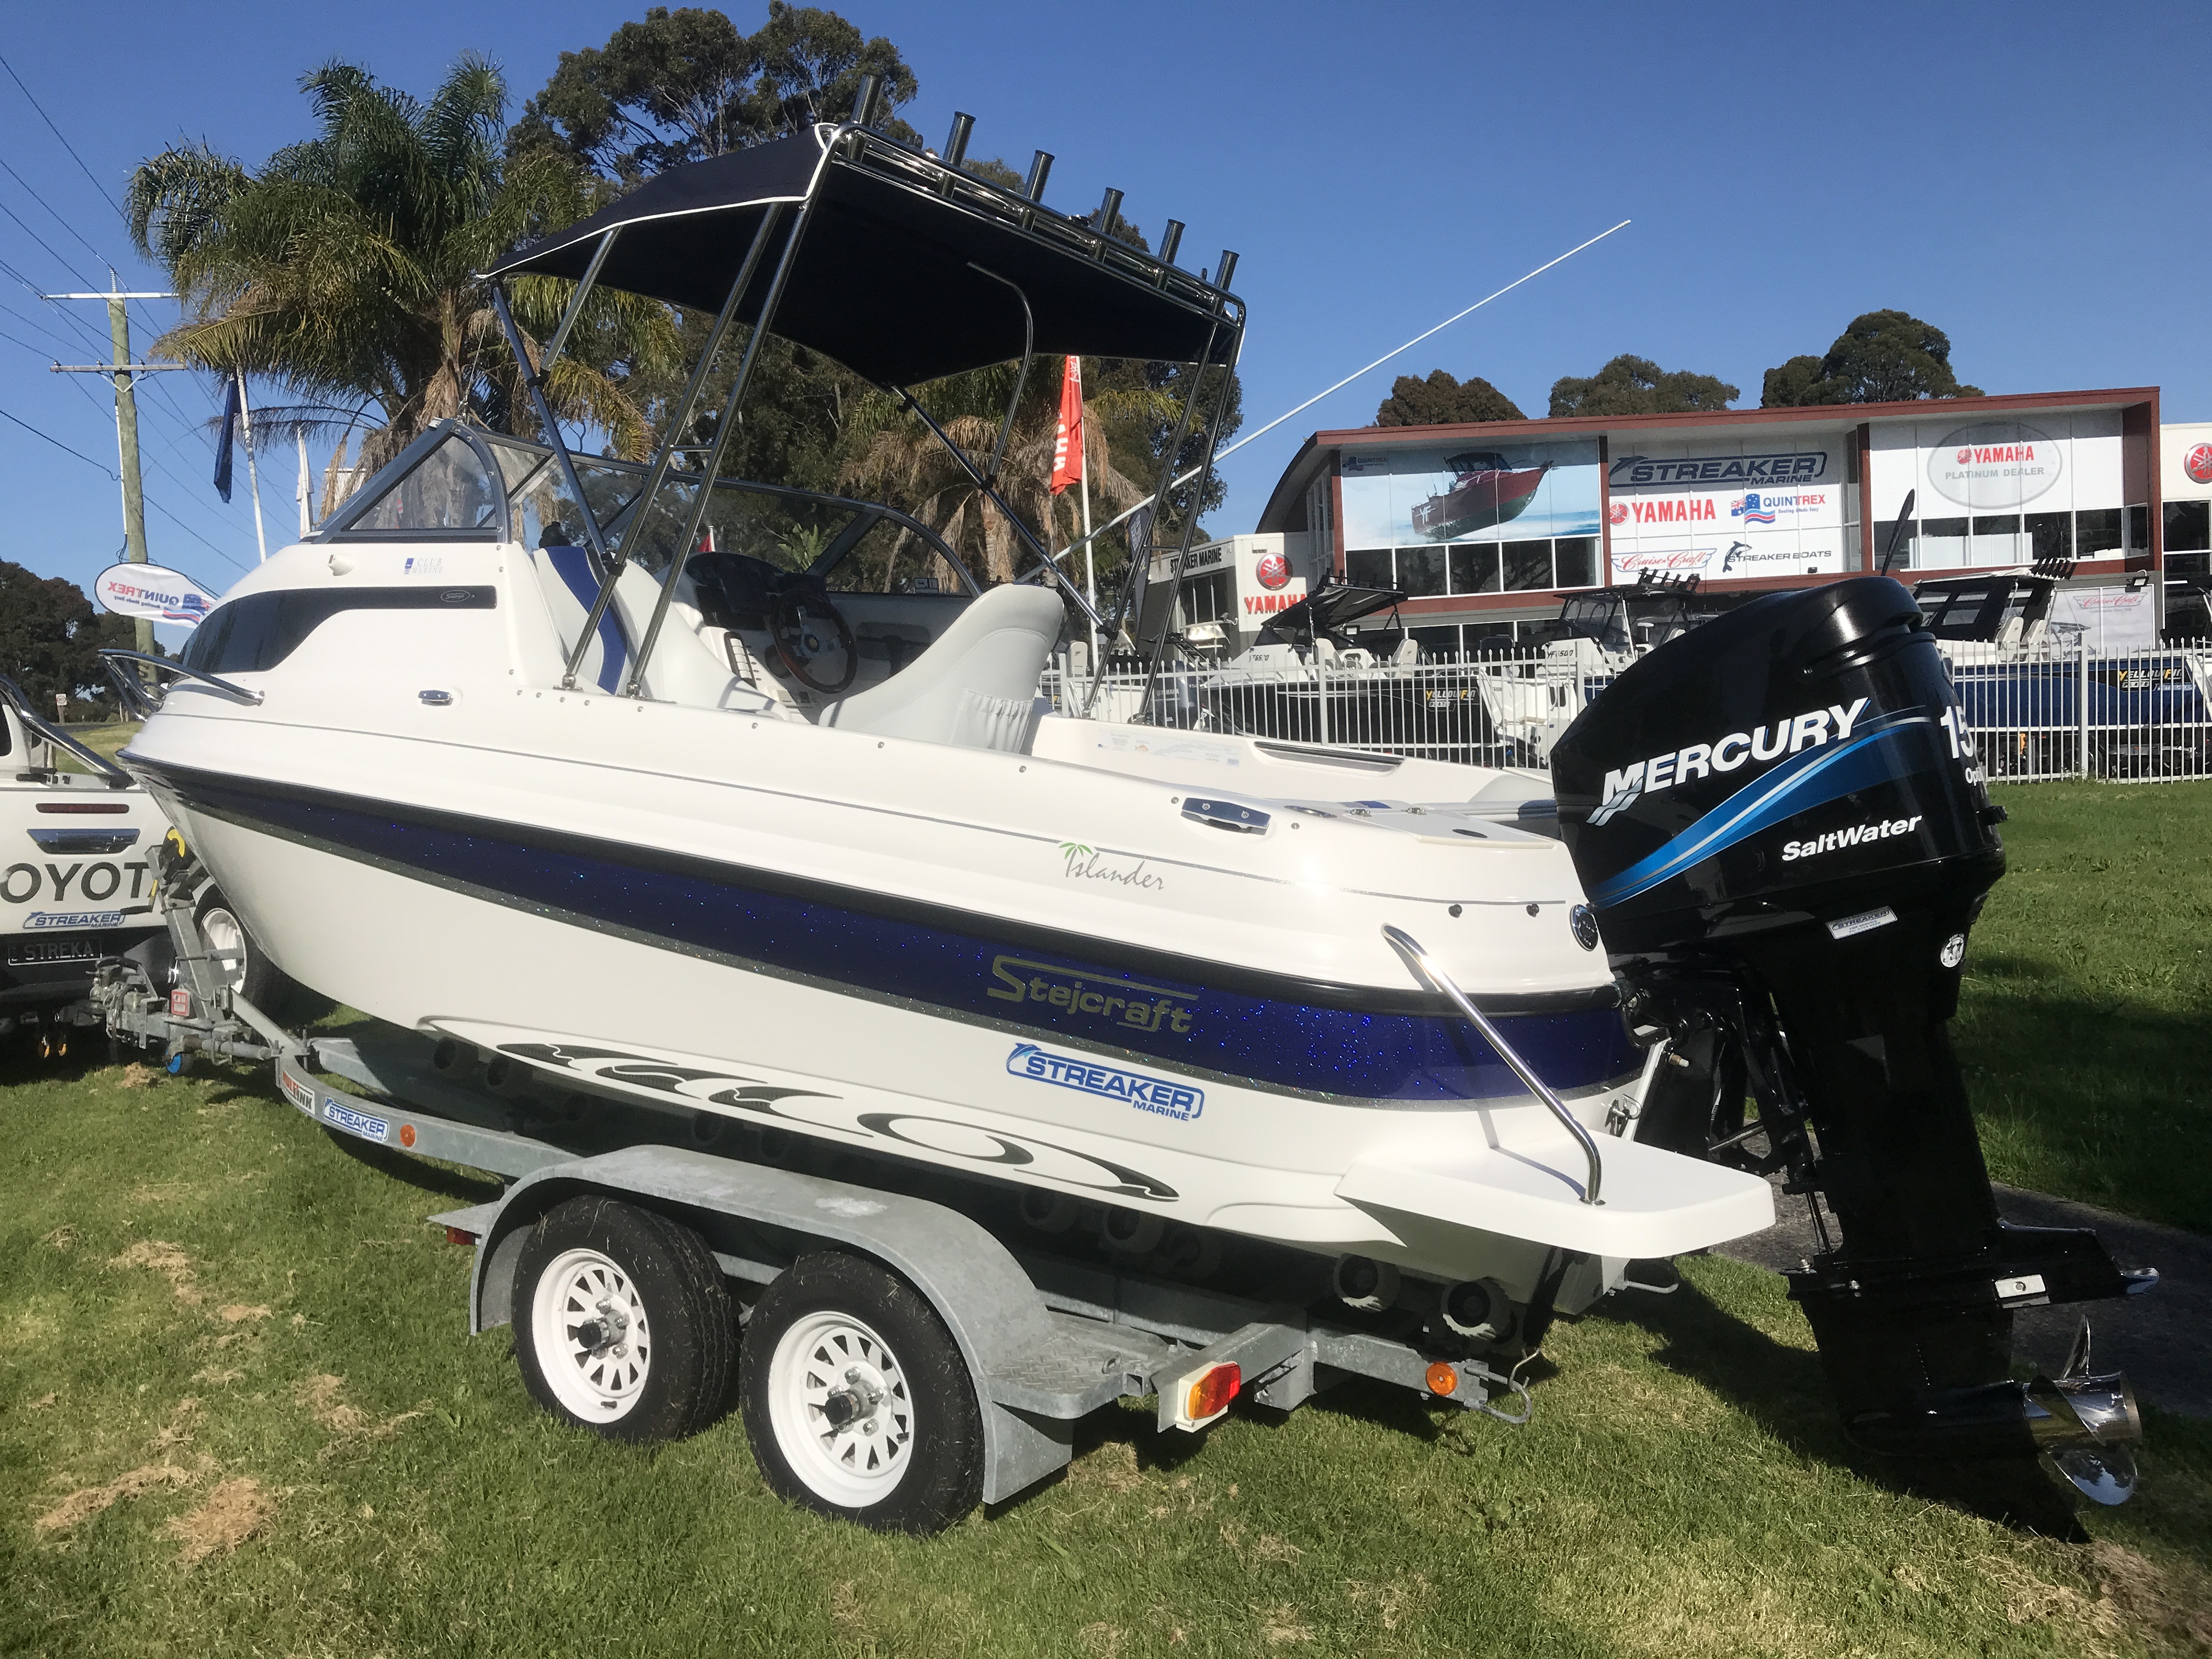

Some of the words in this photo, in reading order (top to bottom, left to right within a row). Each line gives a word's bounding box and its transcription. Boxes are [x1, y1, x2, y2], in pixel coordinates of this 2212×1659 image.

[1973, 445, 2034, 464] YAMAHA
[1630, 457, 1817, 482] STREAKER
[1750, 474, 1813, 485] MARINE
[1945, 469, 1998, 479] PLATINUM
[2004, 467, 2045, 477] DEALER
[1632, 499, 1717, 523] YAMAHA
[1763, 494, 1826, 507] QUINTREX
[417, 558, 442, 566] CLUB
[1170, 552, 1198, 573] STAKER
[1199, 547, 1222, 566] MARINE
[1728, 553, 1791, 563] STREAKER
[1793, 551, 1832, 560] BOATS
[1587, 697, 1869, 826] MERCURY
[1782, 815, 1922, 861] SaltWater
[0, 862, 154, 903] OYOT
[35, 913, 122, 926] STREAKER
[988, 954, 1199, 1033] Stejcraft
[1025, 1054, 1197, 1112] STREAKER
[329, 1106, 385, 1136] STREAKER
[1132, 1100, 1189, 1121] MARINE
[363, 1131, 383, 1141] MARINE
